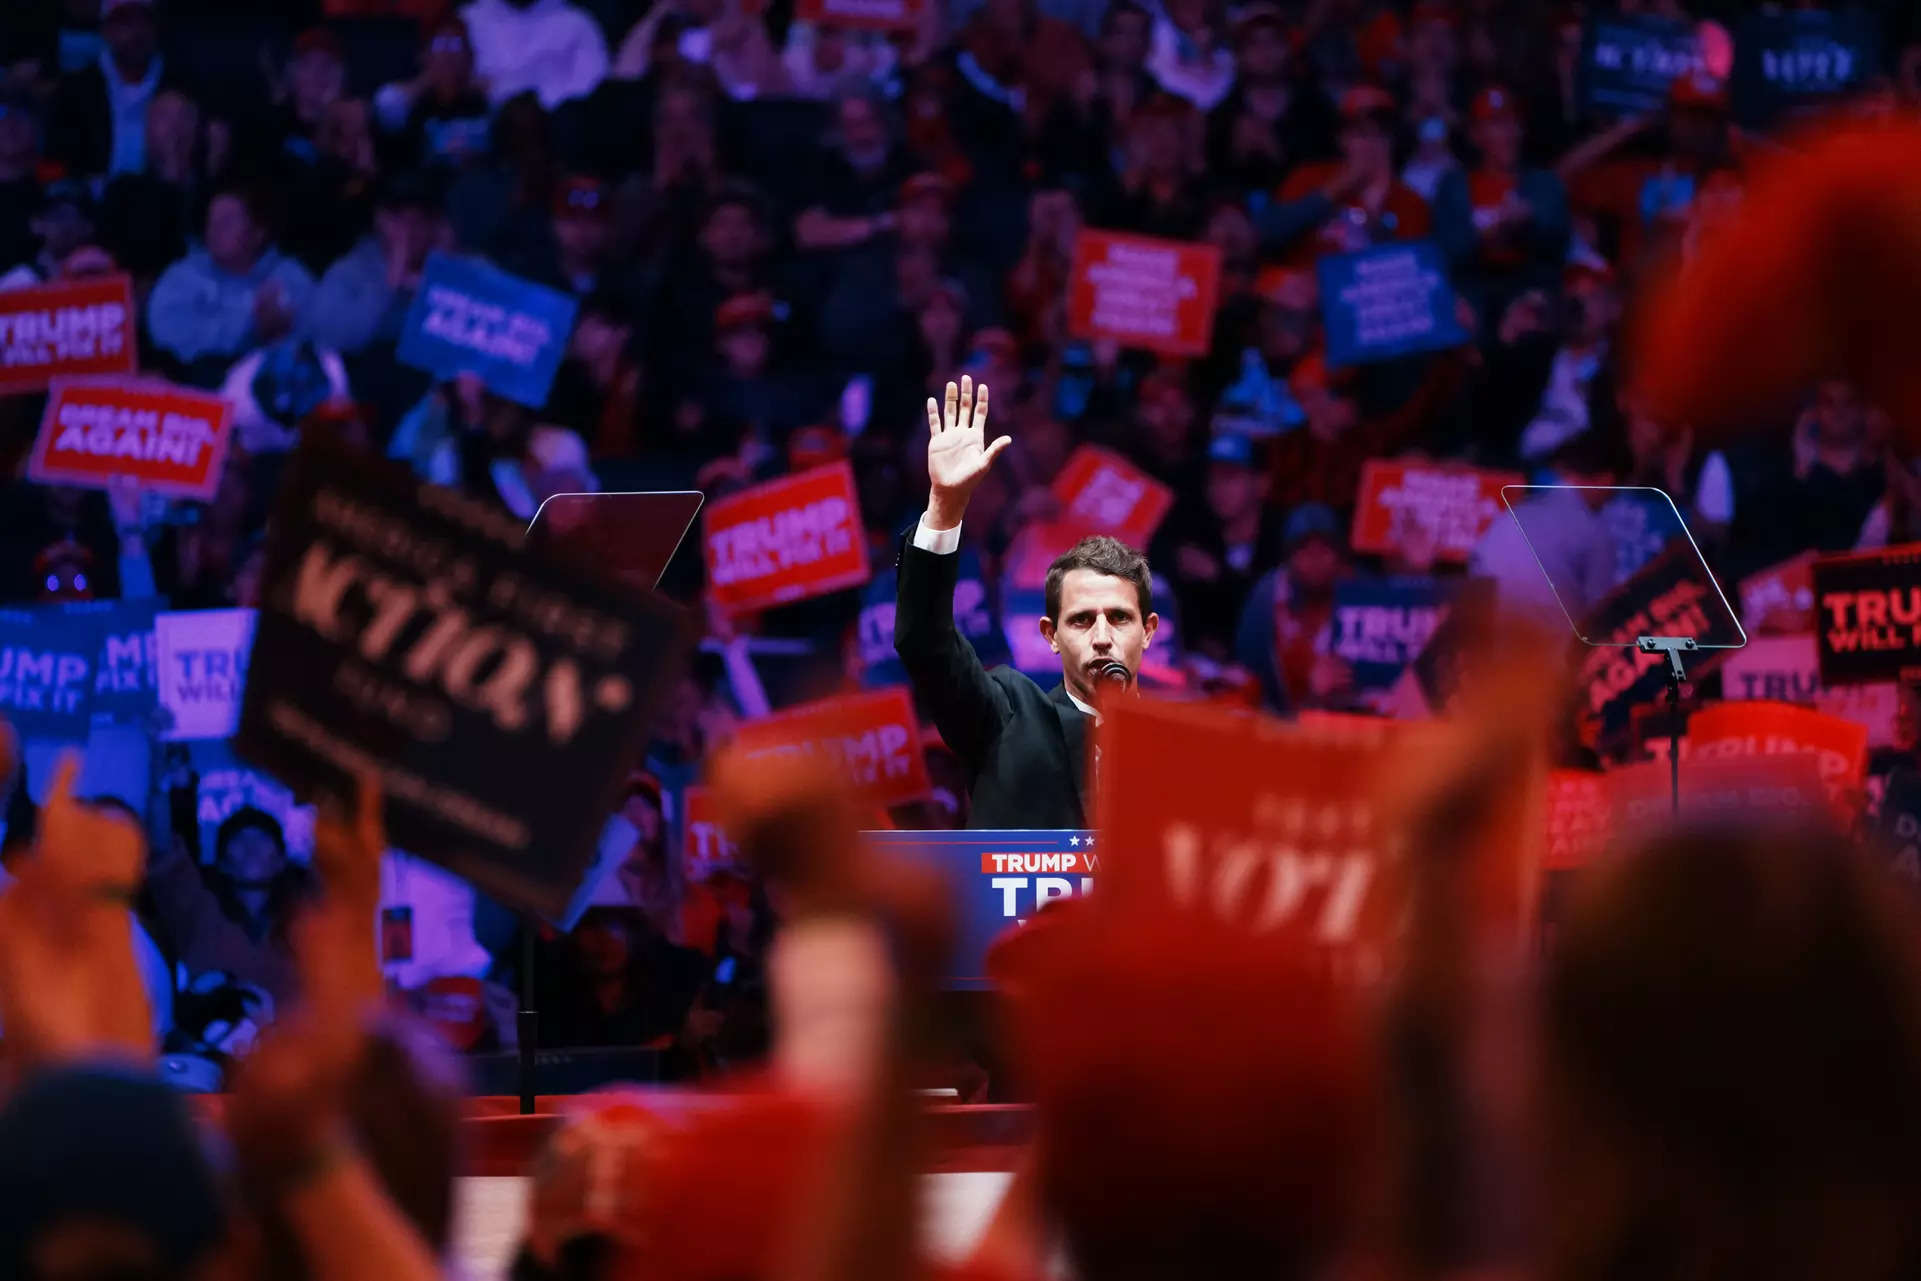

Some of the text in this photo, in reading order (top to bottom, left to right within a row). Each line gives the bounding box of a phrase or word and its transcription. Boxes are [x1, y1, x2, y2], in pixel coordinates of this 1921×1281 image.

[55, 424, 202, 468] AGAIN!
[710, 497, 848, 567] TRUMP
[1824, 587, 1921, 627] TRU
[1827, 624, 1905, 652] WILL
[991, 853, 1077, 873] TRUMP
